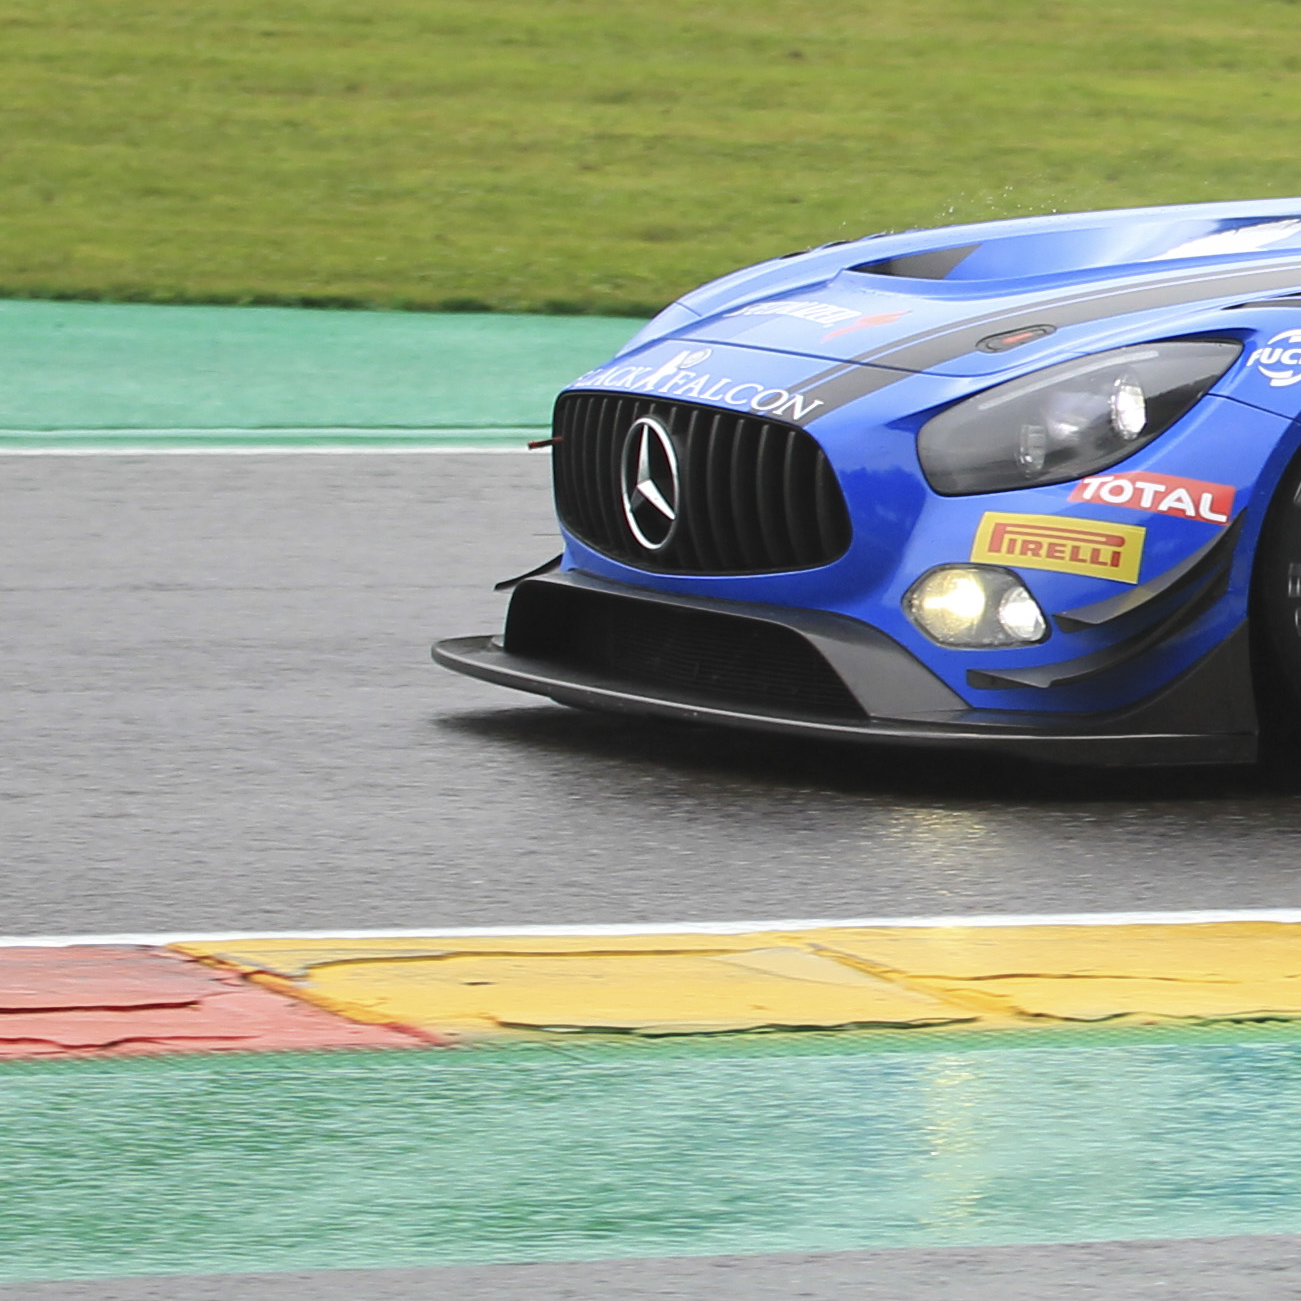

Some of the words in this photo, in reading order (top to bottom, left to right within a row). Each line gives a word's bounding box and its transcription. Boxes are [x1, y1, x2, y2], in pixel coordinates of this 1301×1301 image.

[659, 371, 824, 421] FALCON
[1081, 475, 1229, 522] TOTAL
[988, 522, 1126, 568] PIRELLI
